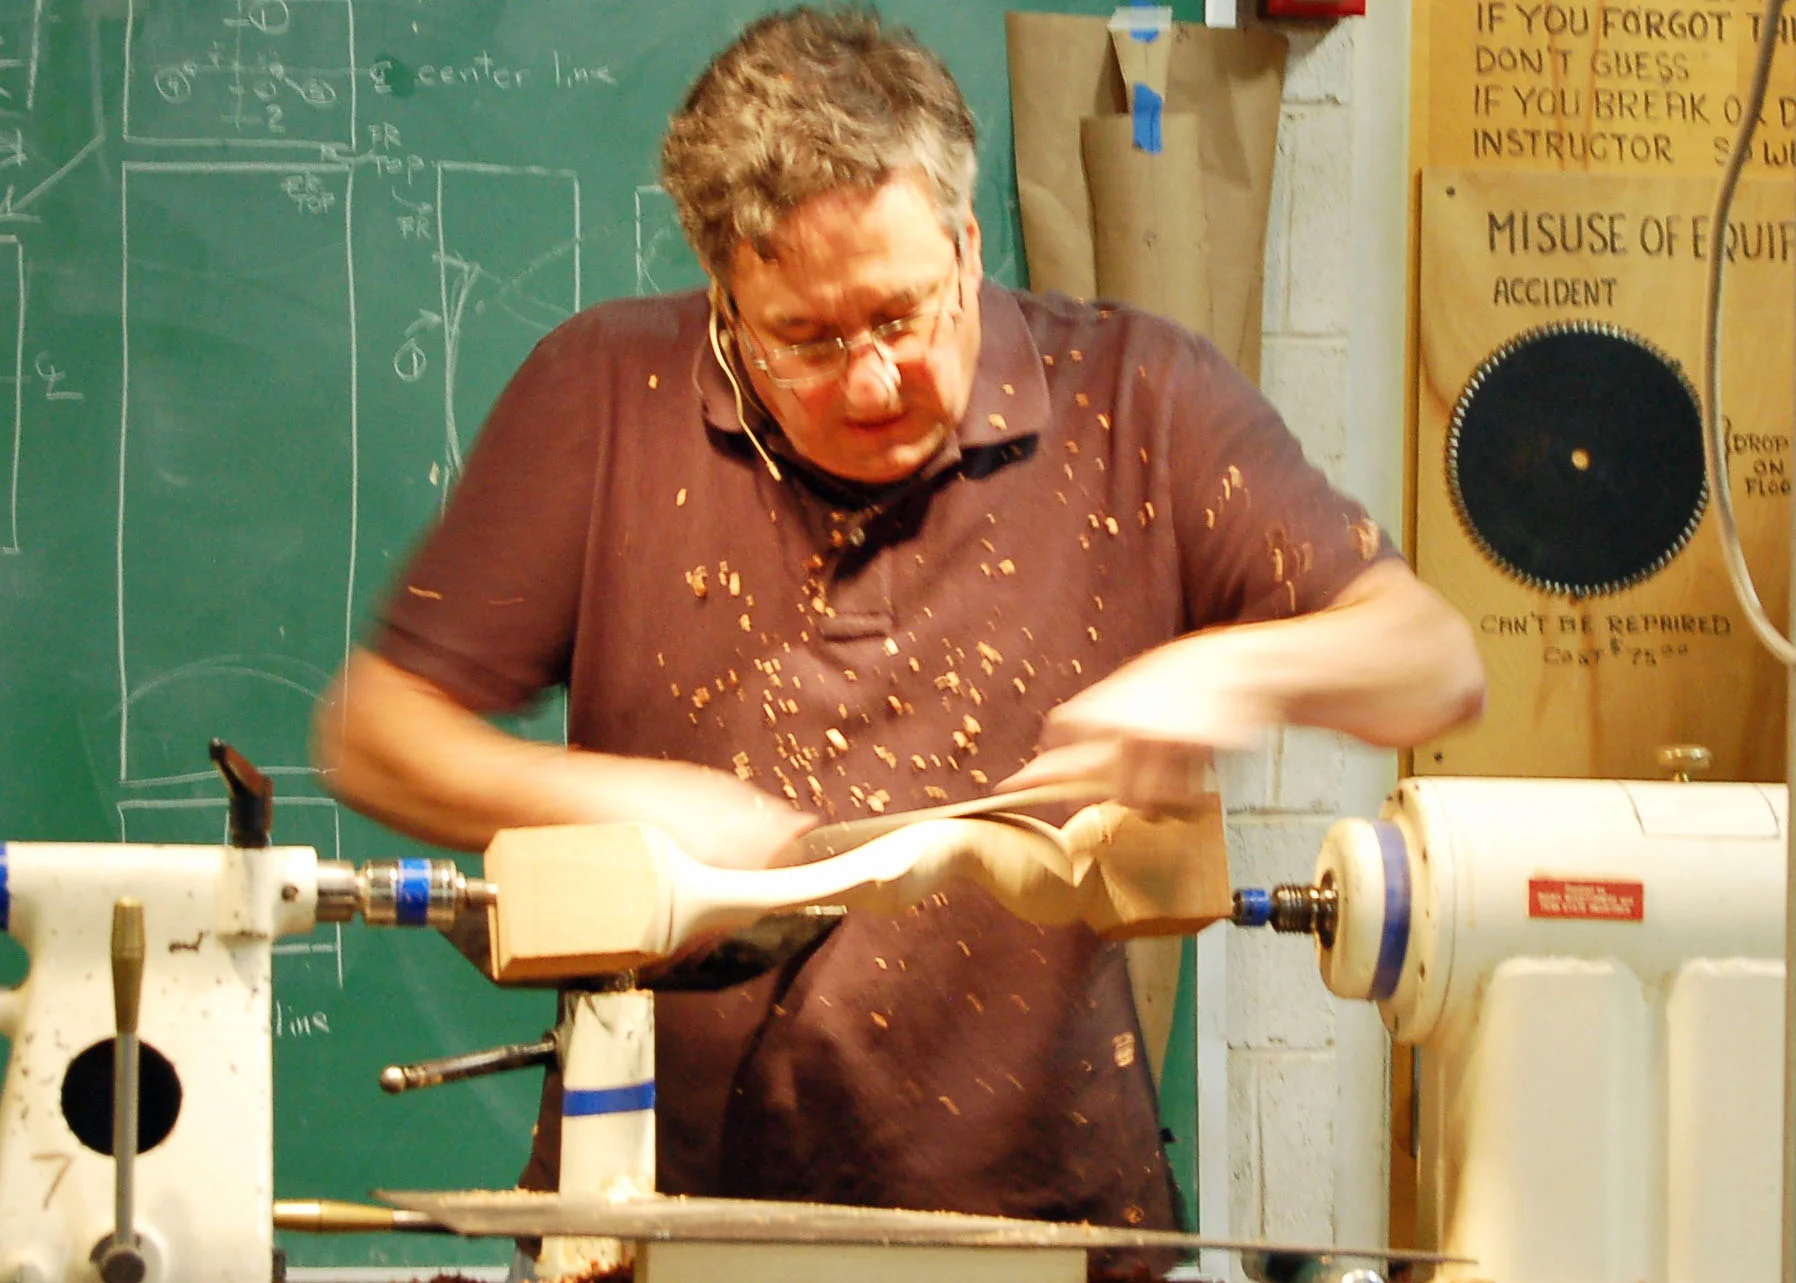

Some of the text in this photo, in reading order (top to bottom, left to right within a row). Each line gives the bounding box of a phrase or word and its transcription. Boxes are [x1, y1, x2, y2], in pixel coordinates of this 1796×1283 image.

[1476, 1, 1506, 34] IF
[1515, 3, 1590, 37] YOU
[1602, 6, 1732, 42] FORGOT
[416, 50, 531, 89] center
[553, 50, 618, 89] line
[1475, 45, 1690, 84] DON'T GUESS
[1474, 84, 1504, 117] IF
[1512, 85, 1580, 118] YOU
[1594, 87, 1710, 126] BREAK
[1473, 127, 1674, 164] INSTRUCTOR
[1487, 209, 1628, 256] MISUSE
[1640, 213, 1682, 257] OF
[1493, 276, 1618, 307] ACCIDENT
[1733, 432, 1790, 454] DROP
[1752, 459, 1785, 476] ON
[1479, 611, 1546, 636] CAN'T
[1607, 615, 1732, 636] REPAIRED
[276, 1000, 330, 1038] line
[30, 1151, 74, 1210] 7
